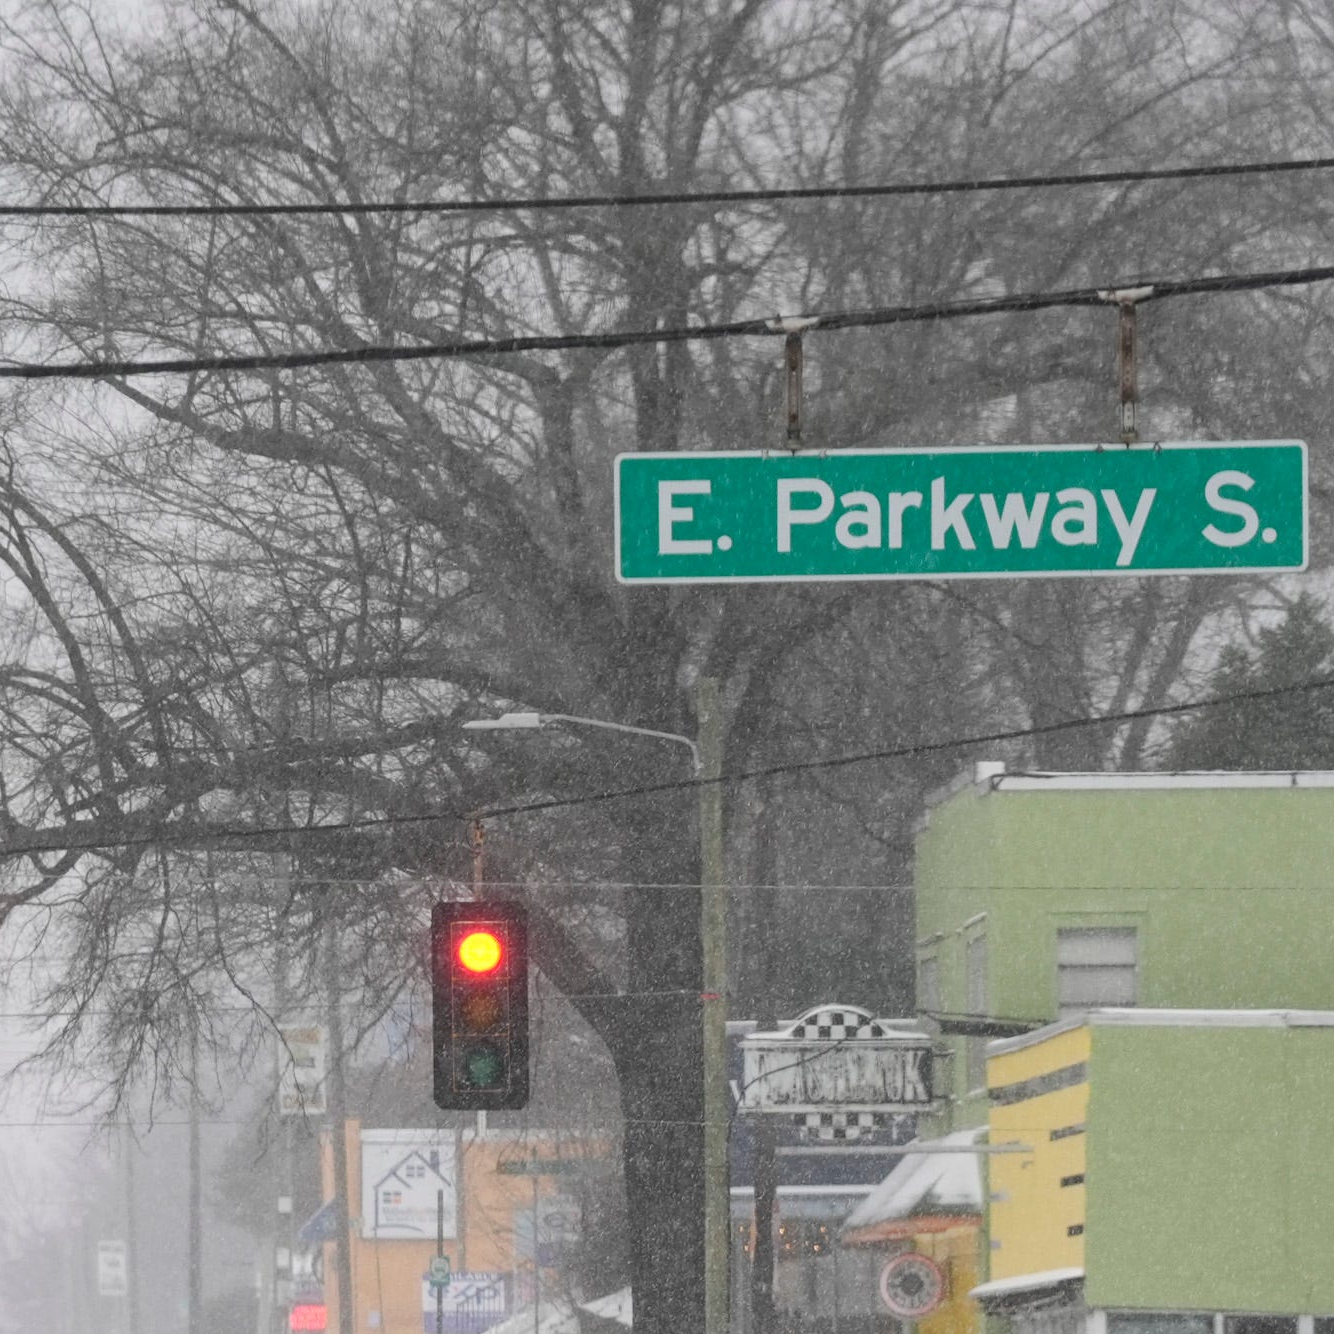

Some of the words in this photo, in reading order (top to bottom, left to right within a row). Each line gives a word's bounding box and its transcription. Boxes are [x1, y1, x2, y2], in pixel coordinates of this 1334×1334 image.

[657, 479, 734, 556] E.
[777, 475, 1158, 567] Parkway
[1202, 469, 1280, 547] S.
